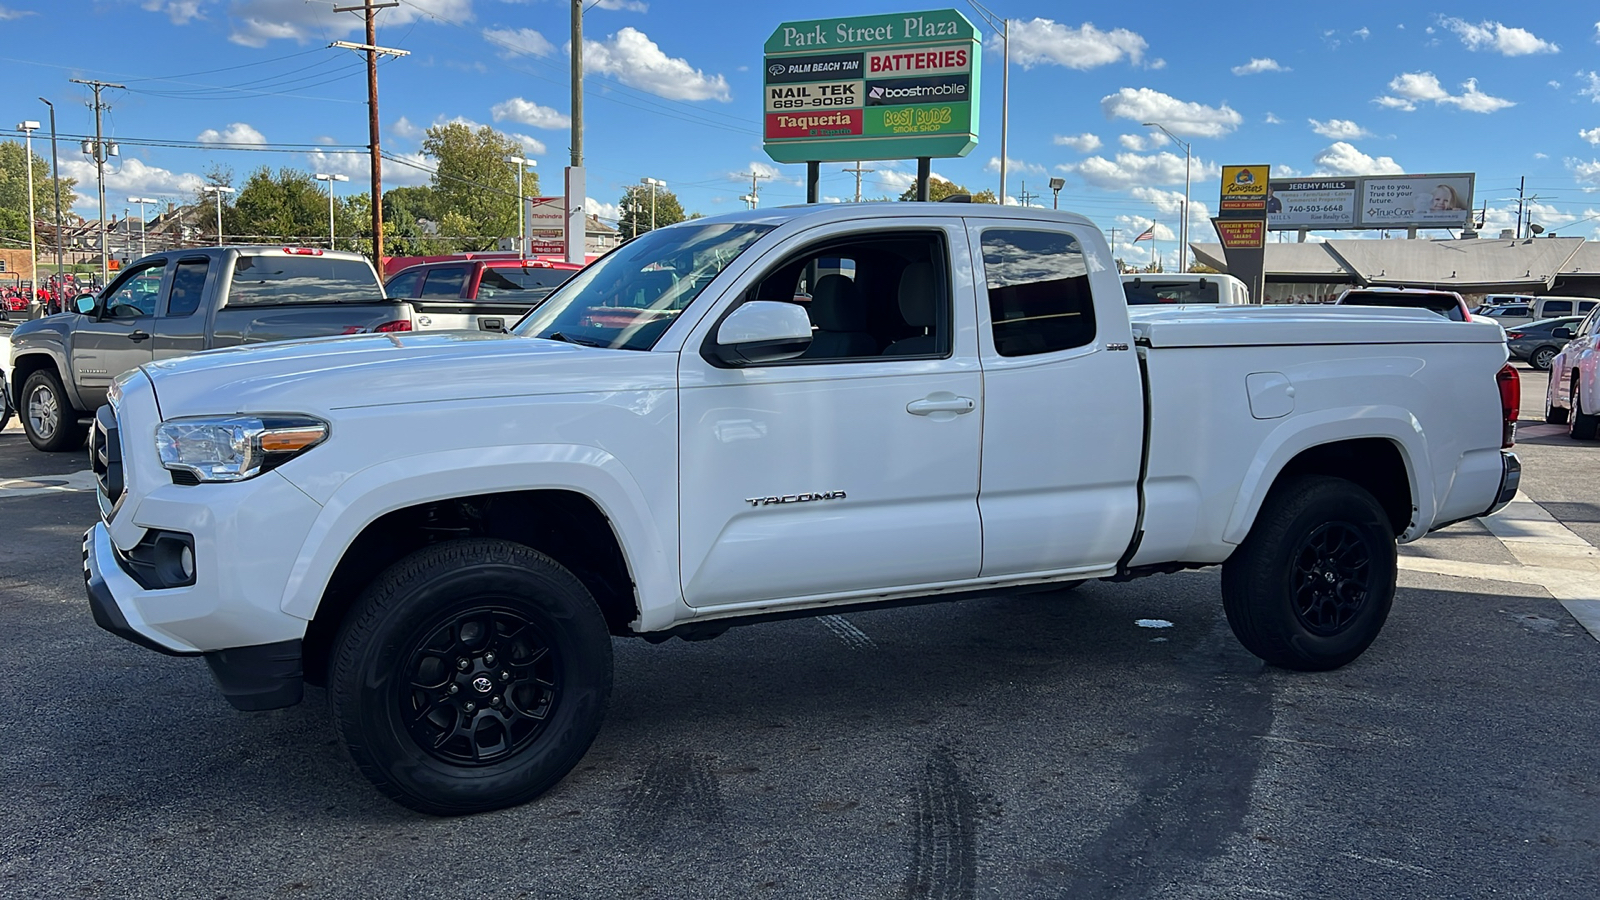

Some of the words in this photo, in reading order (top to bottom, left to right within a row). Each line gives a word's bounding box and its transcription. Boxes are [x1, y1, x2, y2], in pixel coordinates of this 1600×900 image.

[783, 25, 827, 47] Park
[836, 23, 893, 43] Street
[903, 16, 958, 38] Plaza
[870, 49, 967, 73] BATTERIES
[788, 64, 811, 74] PALM
[812, 62, 840, 72] BEACH
[842, 60, 859, 70] TAN
[771, 87, 811, 99] NAIL
[818, 84, 855, 96] TEK
[773, 96, 854, 109] 689-9088
[893, 125, 918, 133] SMOKE
[919, 124, 940, 132] SHOP
[1322, 181, 1346, 189] MILLS
[1397, 184, 1412, 192] you.
[1396, 190, 1413, 199] your
[1369, 197, 1394, 205] future.
[1289, 204, 1344, 213] 740-503-6648
[745, 489, 847, 506] TACOMA
